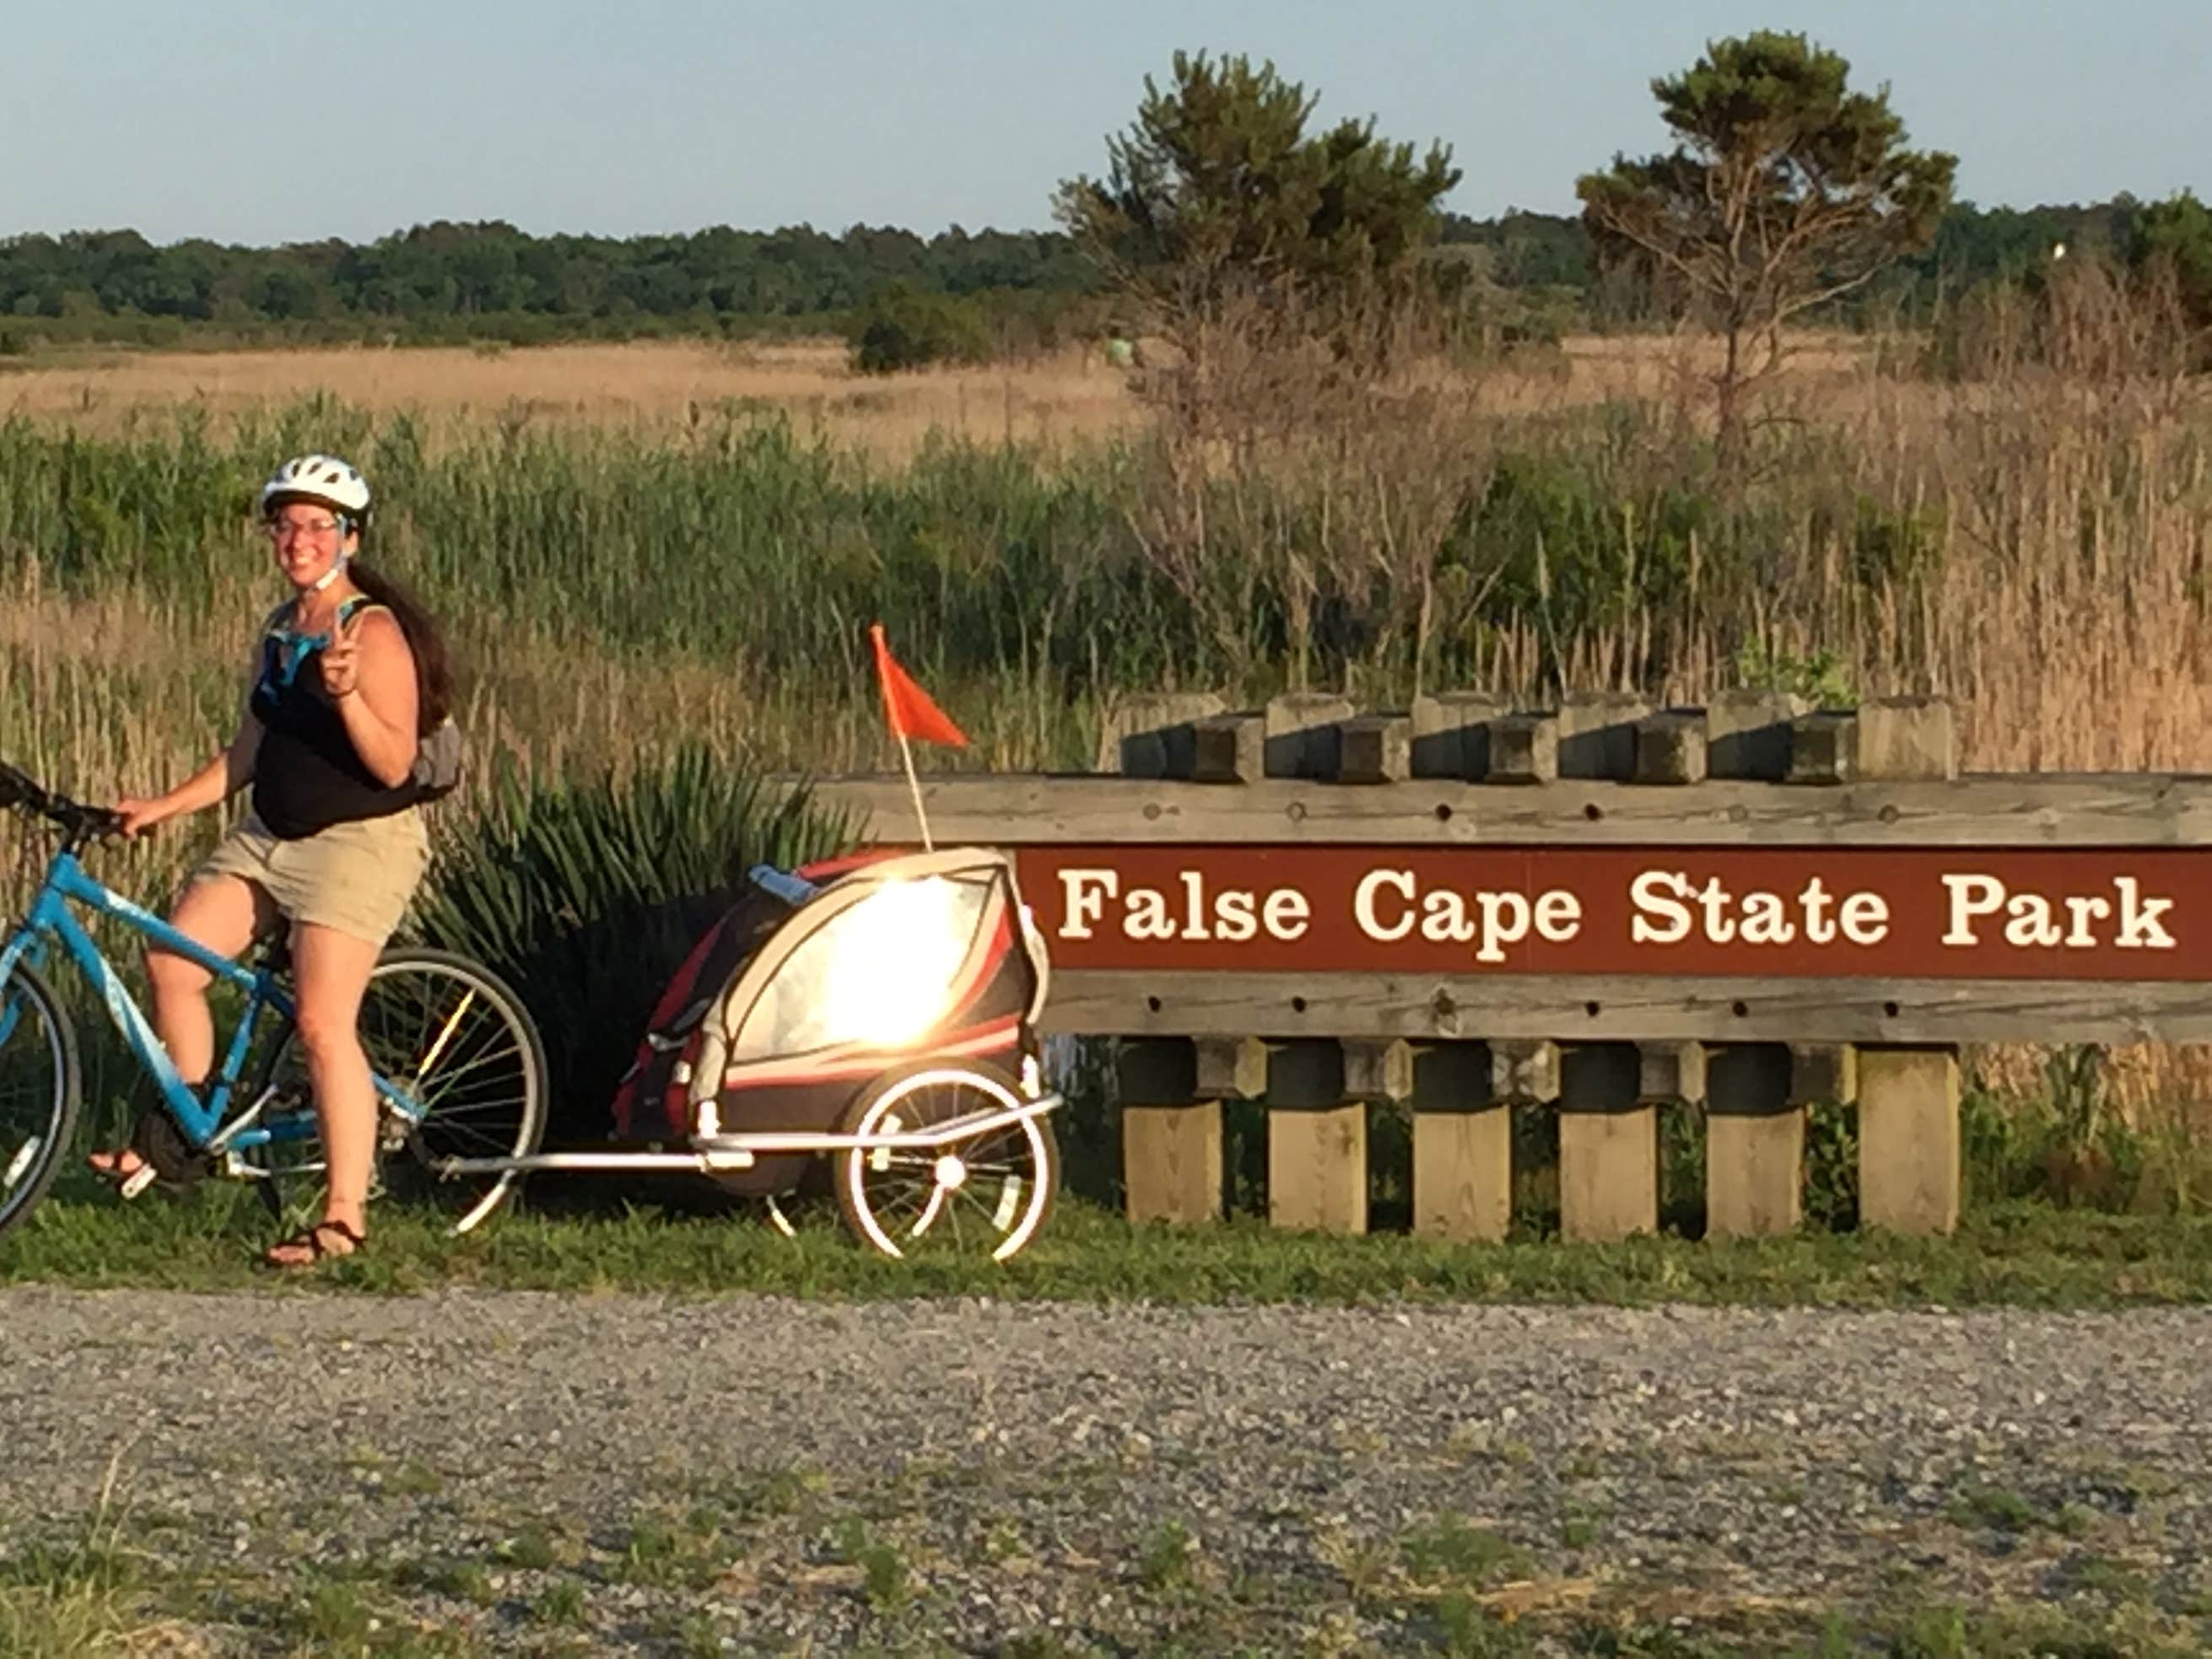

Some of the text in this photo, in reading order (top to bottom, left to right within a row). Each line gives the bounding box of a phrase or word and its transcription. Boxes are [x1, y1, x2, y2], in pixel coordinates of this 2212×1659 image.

[1058, 869, 2177, 962] False Cape State Park
